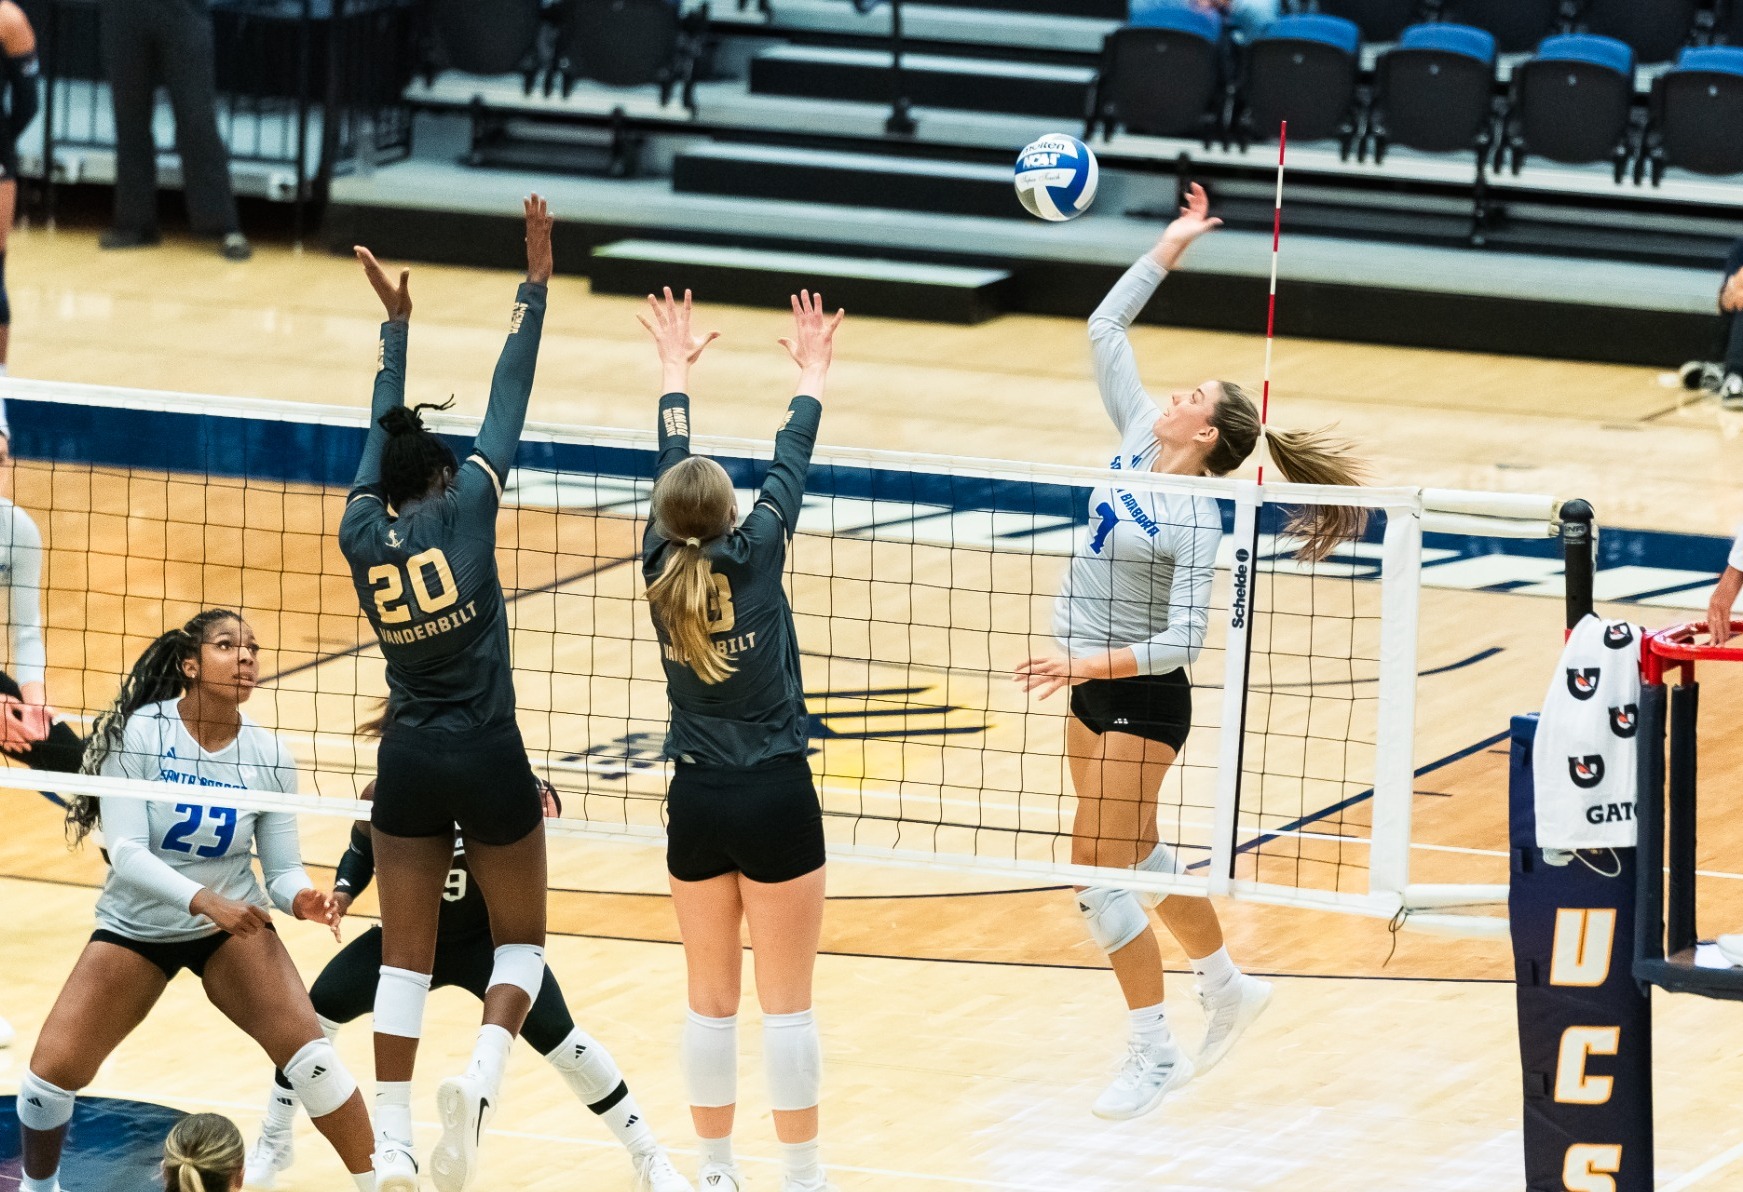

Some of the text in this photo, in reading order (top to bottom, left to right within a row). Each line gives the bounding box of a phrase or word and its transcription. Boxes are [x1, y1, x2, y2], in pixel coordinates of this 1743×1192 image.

[1120, 492, 1160, 537] BARBARA
[368, 547, 459, 624] 20
[1232, 564, 1248, 629] Schelde
[380, 600, 477, 645] VANDERBILT
[161, 803, 237, 858] 23
[1586, 802, 1638, 824] GAT
